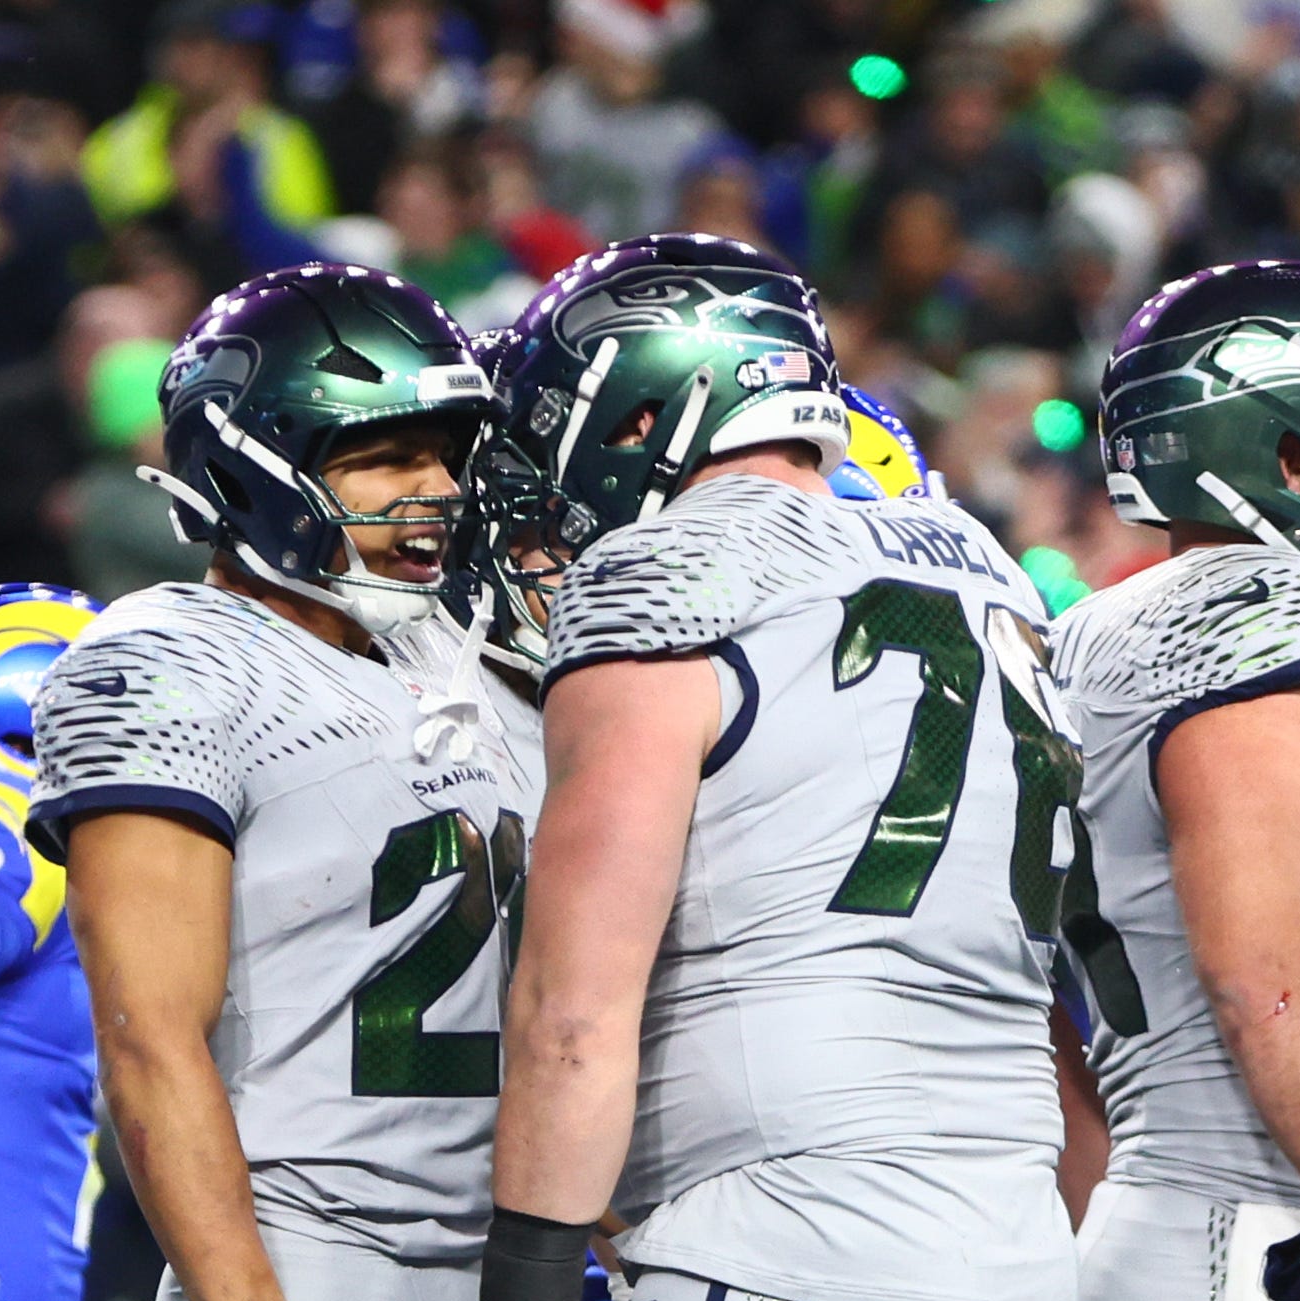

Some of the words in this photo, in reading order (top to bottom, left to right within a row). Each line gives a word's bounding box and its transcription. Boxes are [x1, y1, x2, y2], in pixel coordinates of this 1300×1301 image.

[736, 362, 767, 388] 45
[820, 405, 842, 424] AS
[411, 766, 498, 797] SEAHAW
